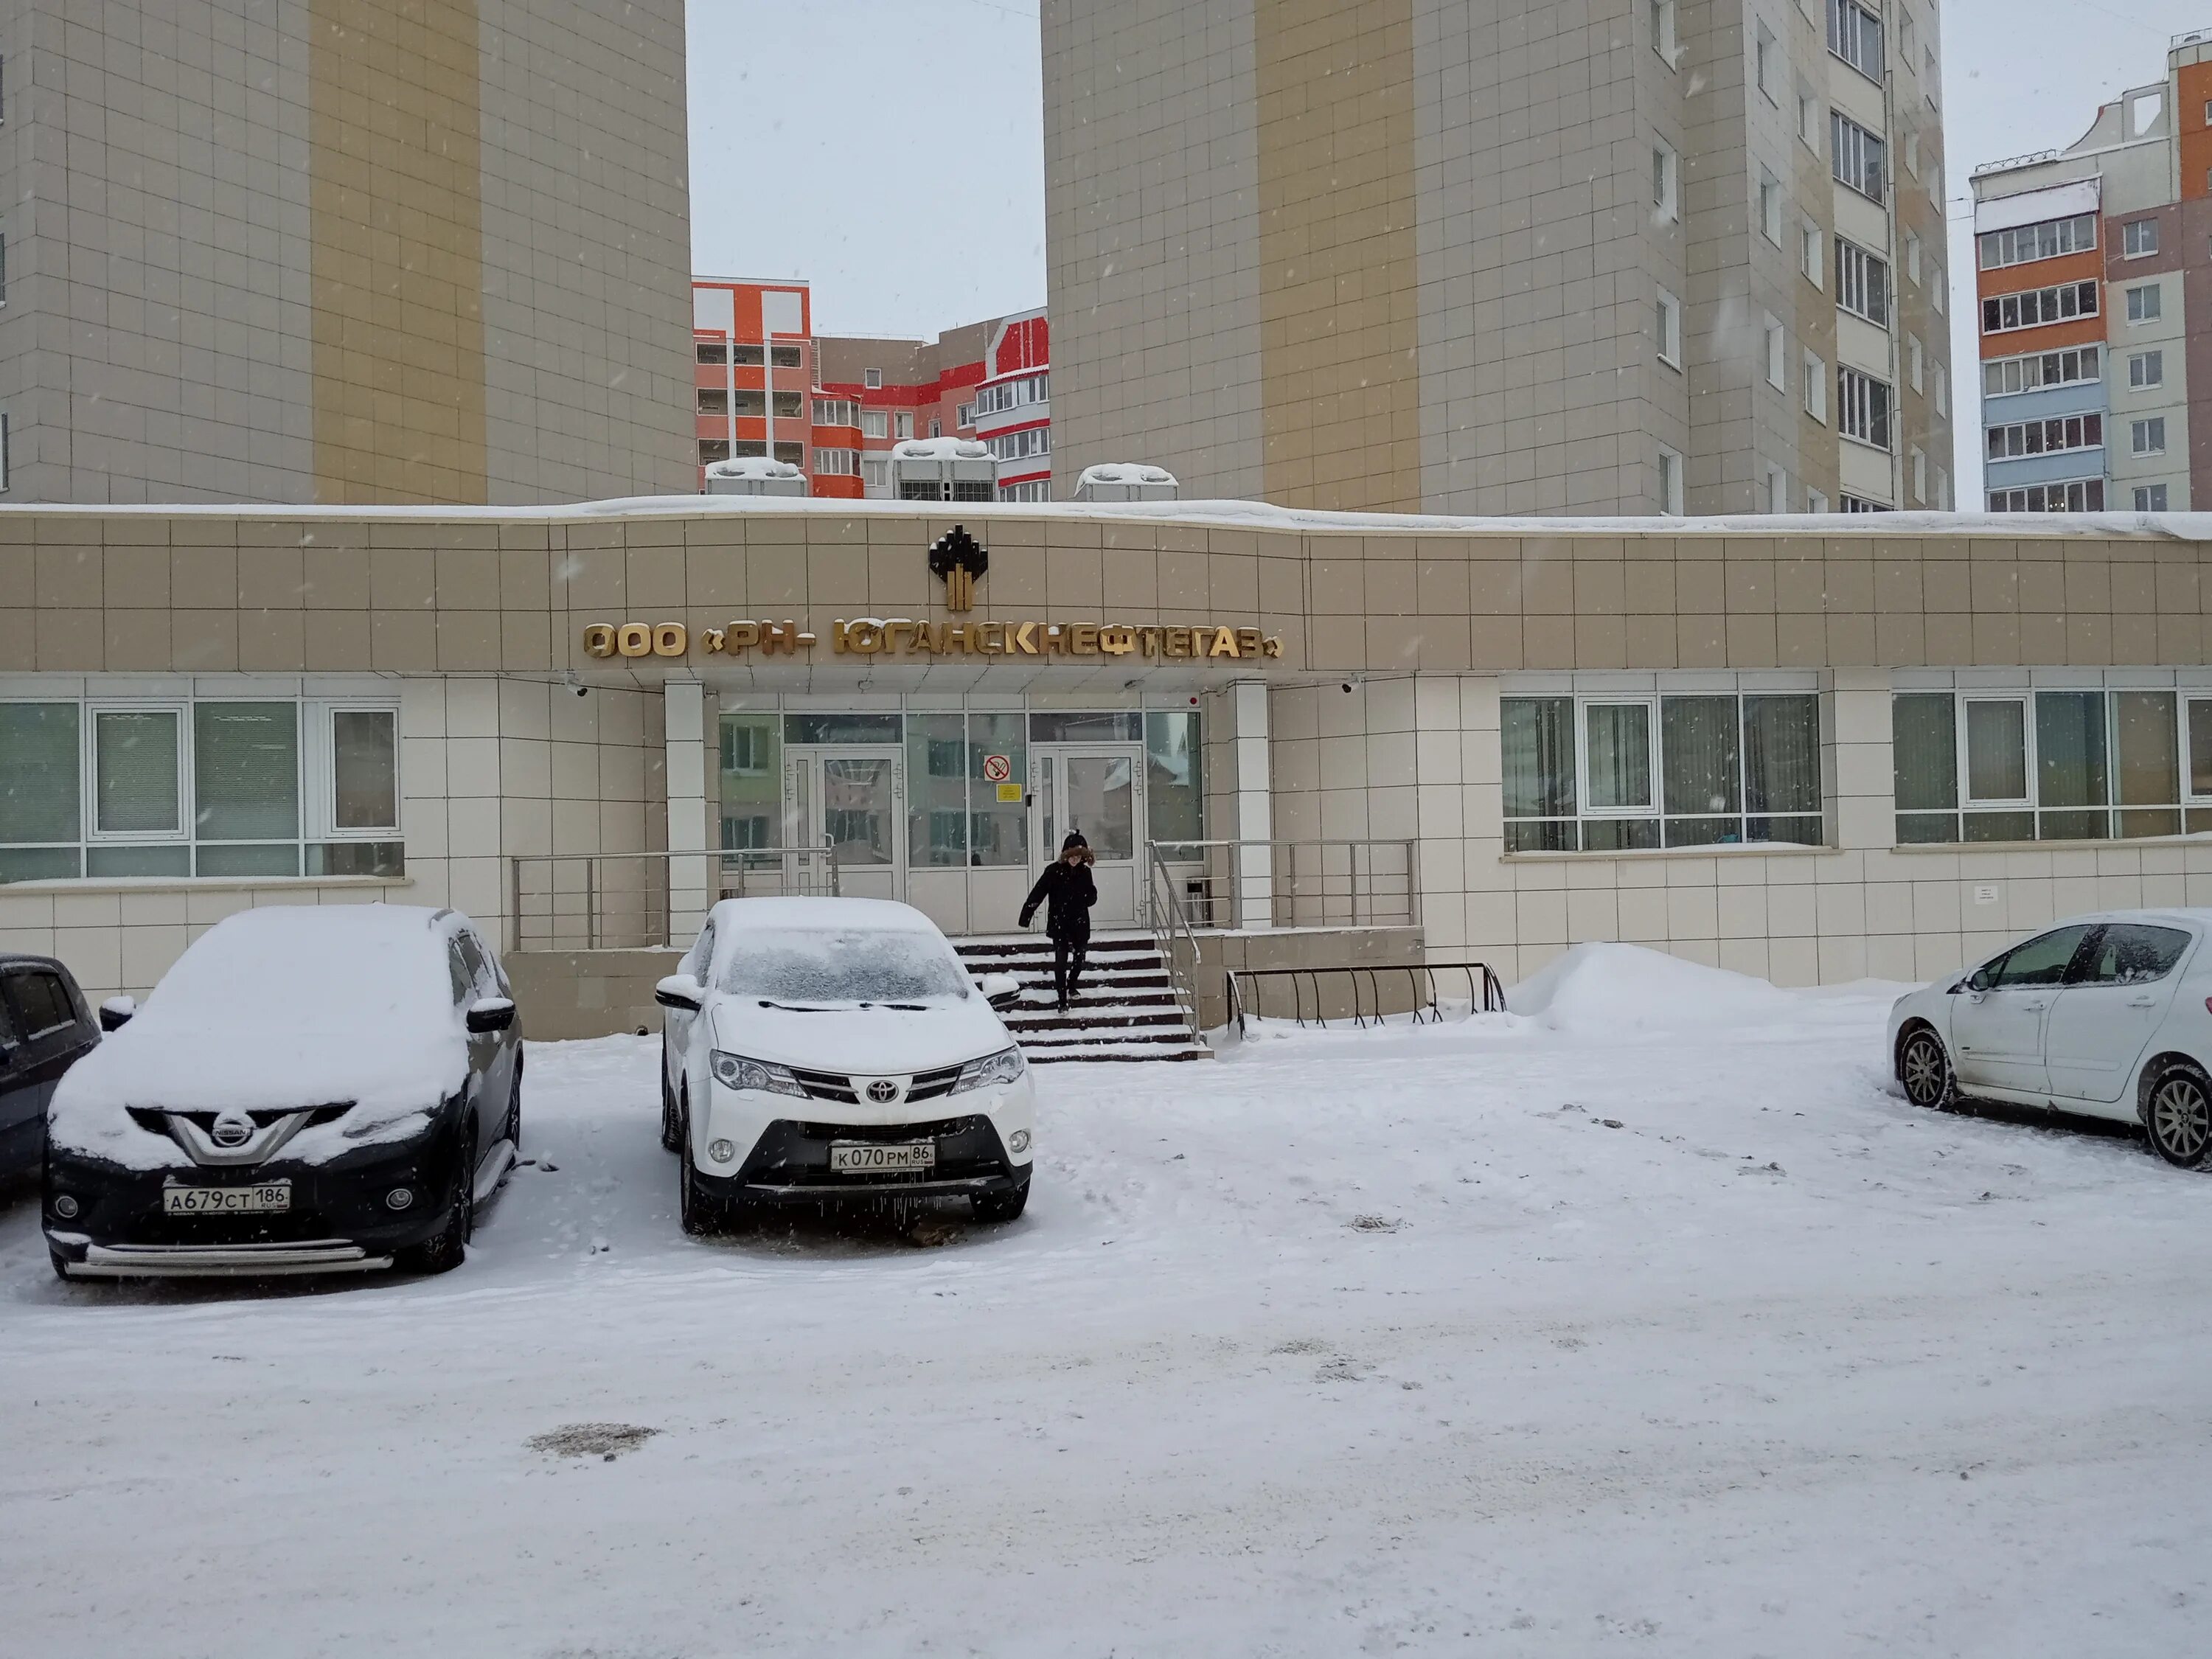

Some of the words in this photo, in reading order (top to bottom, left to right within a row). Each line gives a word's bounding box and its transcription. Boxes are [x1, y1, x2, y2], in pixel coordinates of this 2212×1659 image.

[583, 622, 687, 658] ООО
[913, 1147, 929, 1159] 86
[256, 1189, 285, 1203] 186
